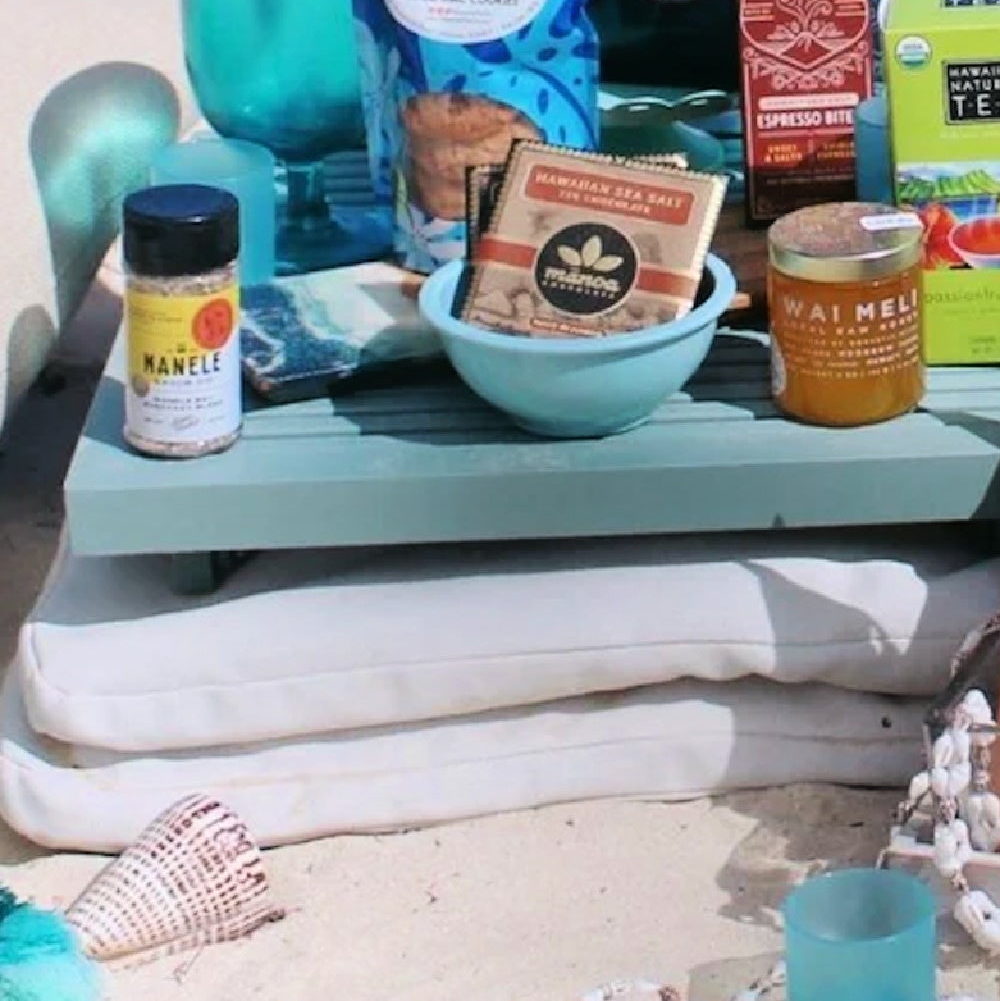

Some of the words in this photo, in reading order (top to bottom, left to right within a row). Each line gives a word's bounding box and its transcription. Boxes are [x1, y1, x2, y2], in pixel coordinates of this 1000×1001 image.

[756, 110, 823, 130] ESPRESSO
[824, 109, 855, 126] BITE
[534, 172, 611, 195] HAWAIIAN
[614, 184, 643, 201] SEA
[782, 295, 842, 323] WAI
[855, 287, 919, 323] MELI
[142, 351, 222, 376] MANELE
